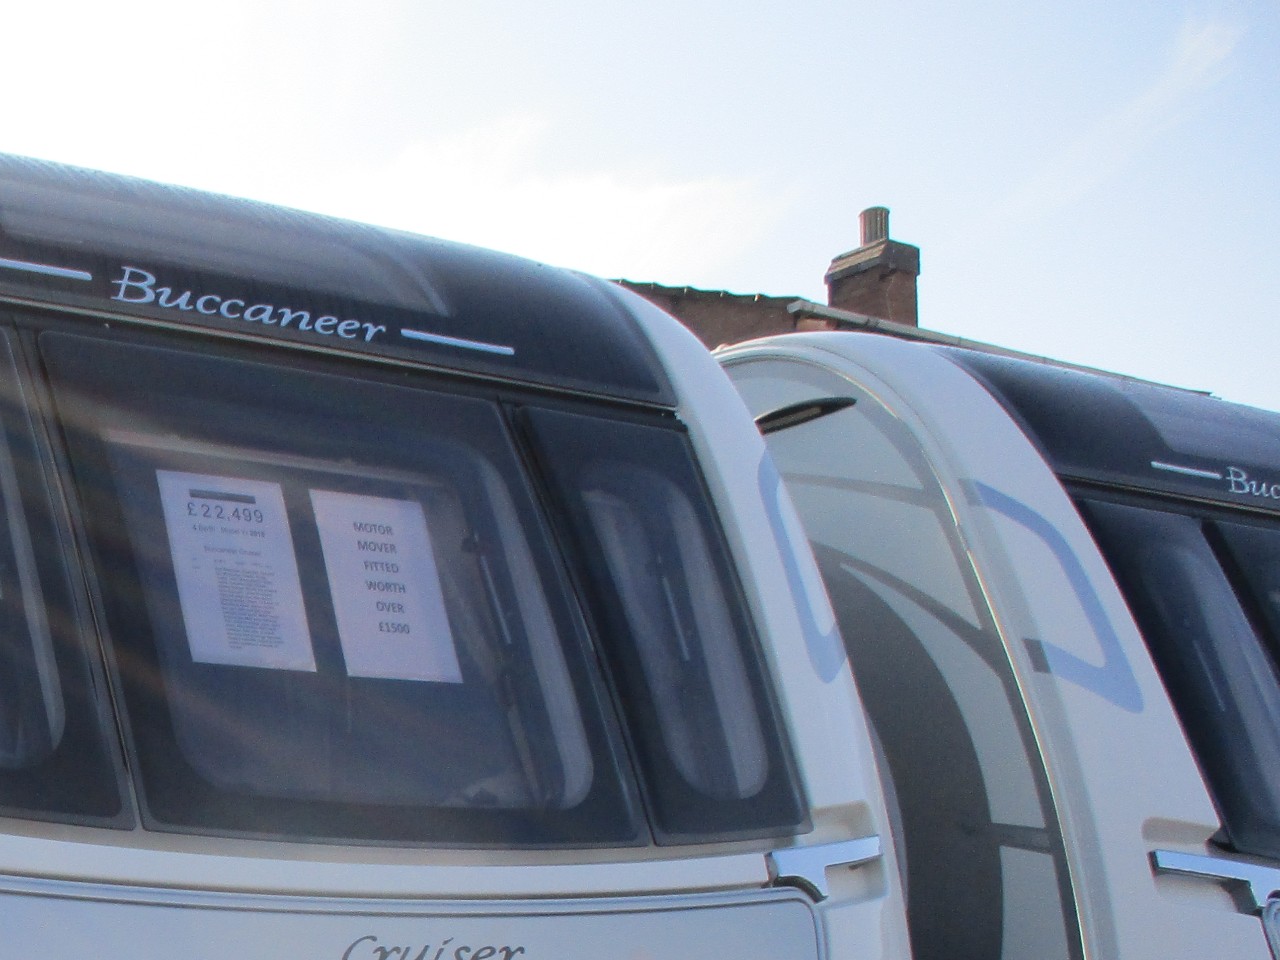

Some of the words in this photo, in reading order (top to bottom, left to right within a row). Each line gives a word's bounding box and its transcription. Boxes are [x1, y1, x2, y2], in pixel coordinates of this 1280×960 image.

[111, 264, 387, 343] Buccaneer
[186, 501, 264, 524] £22,499
[352, 521, 394, 536] MOTOR
[356, 540, 398, 555] MOVER
[363, 560, 400, 574] FITTED
[365, 580, 407, 594] WORTH
[375, 600, 406, 614] OVER
[378, 621, 411, 635] £1500
